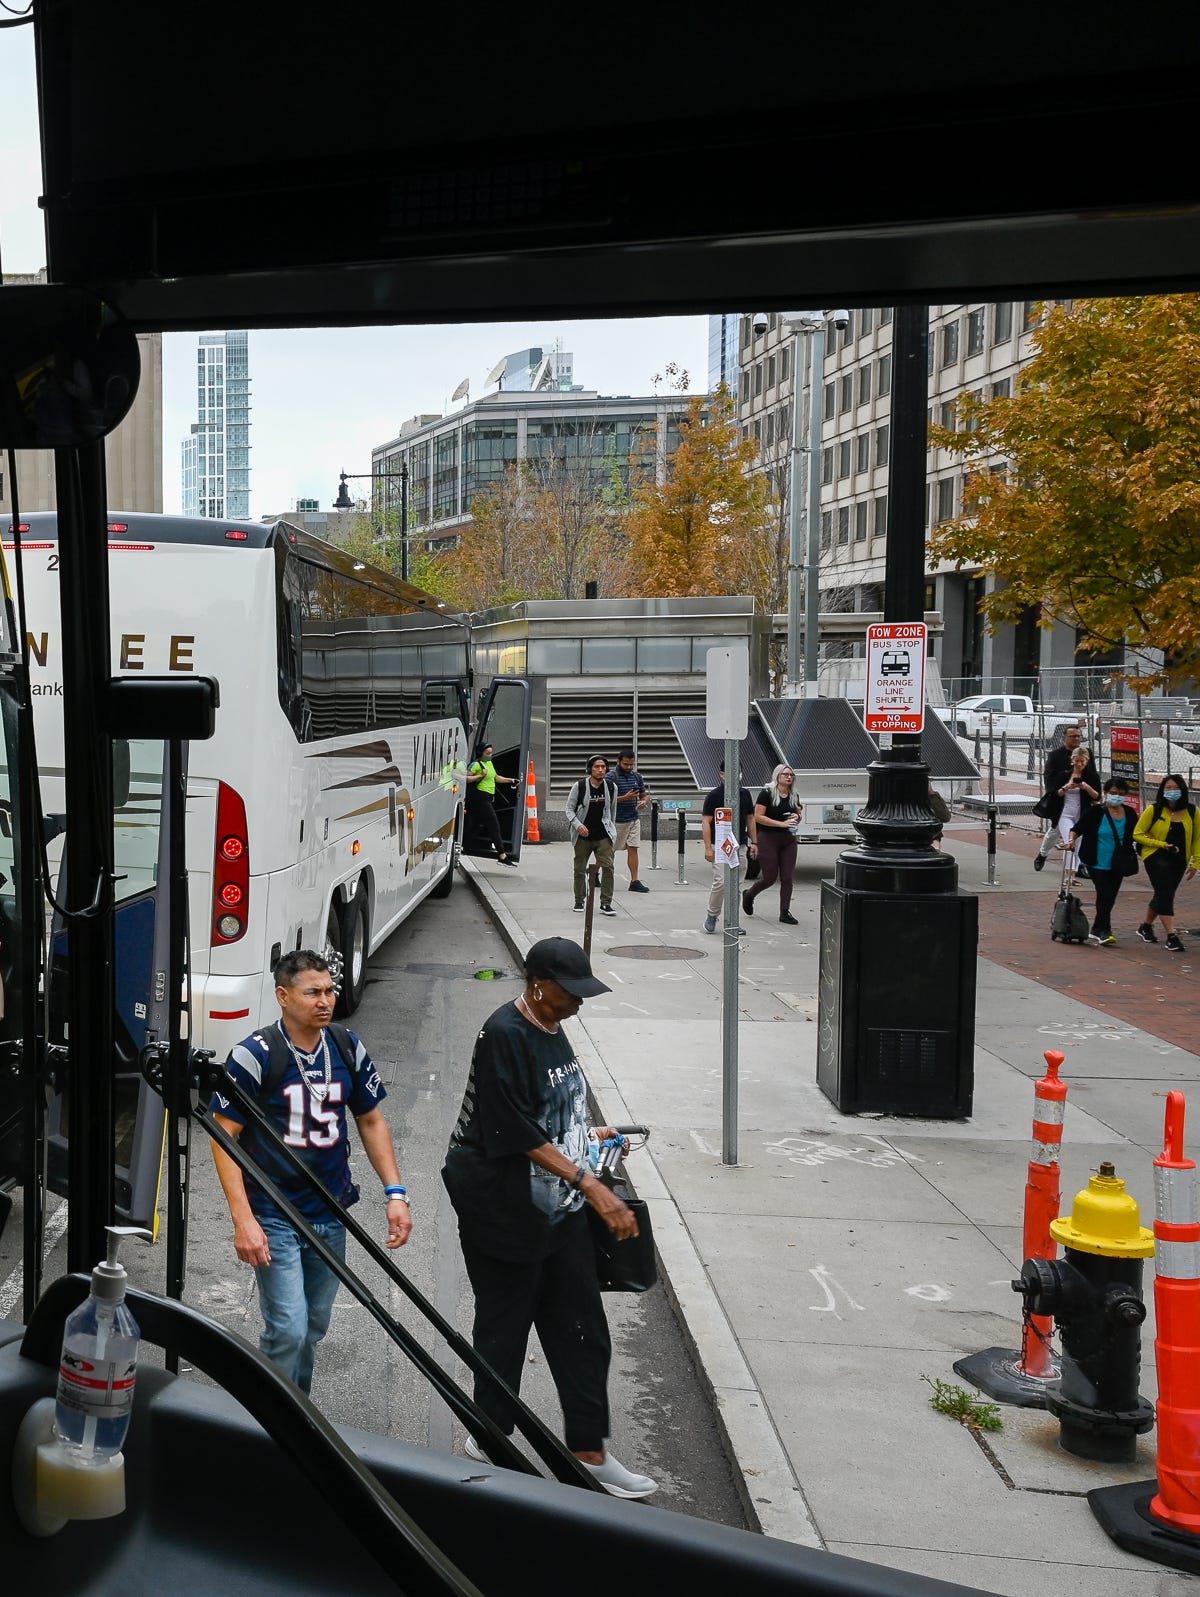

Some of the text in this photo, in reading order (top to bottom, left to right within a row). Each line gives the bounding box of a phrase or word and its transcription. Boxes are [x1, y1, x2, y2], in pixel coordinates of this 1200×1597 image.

[871, 626, 923, 637] TOW ZONE
[872, 640, 921, 649] BUS STOP
[876, 679, 914, 687] ORANGE
[885, 687, 904, 695] LINE
[875, 696, 914, 704] SHUTTLE
[886, 714, 901, 722] NO
[871, 721, 917, 729] STOPPING
[1117, 733, 1139, 741] STEALTH
[412, 726, 460, 789] YANKEE
[283, 1081, 342, 1148] 15
